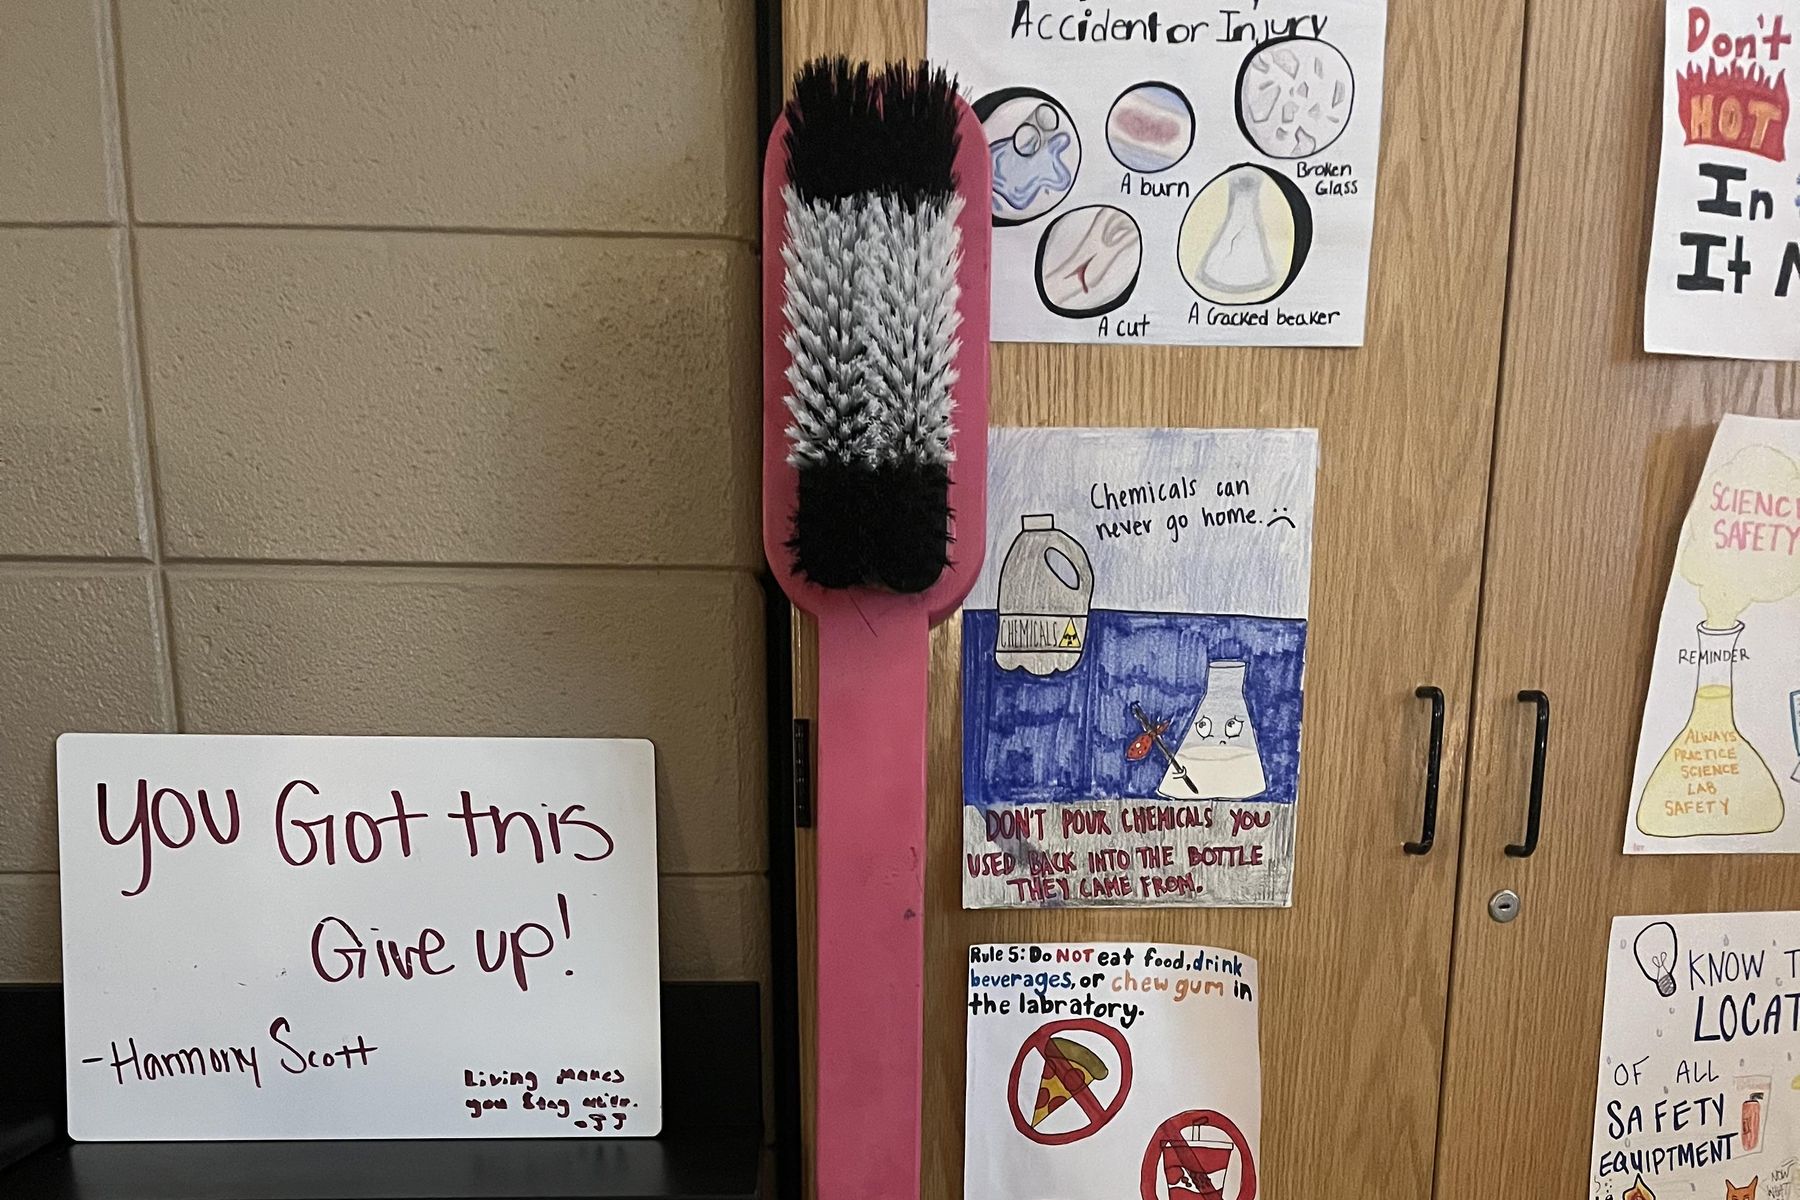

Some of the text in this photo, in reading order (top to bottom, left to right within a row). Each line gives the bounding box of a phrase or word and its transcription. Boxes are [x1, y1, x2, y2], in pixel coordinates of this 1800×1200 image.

[1011, 0, 1327, 45] Accident or Injury
[1687, 6, 1792, 61] Don't
[1690, 94, 1782, 150] HOT
[1121, 173, 1189, 198] A burn
[1297, 162, 1352, 178] Broken
[1316, 179, 1358, 195] Glass
[1697, 162, 1774, 221] In
[1677, 231, 1751, 294] It
[1099, 316, 1150, 337] A cut
[1189, 303, 1340, 325] A Cracked beaker
[1091, 476, 1250, 510] Chemicals can
[1096, 508, 1264, 542] never go home.
[1714, 518, 1800, 556] SAFETY
[1001, 619, 1058, 648] CHEMICALS
[1679, 648, 1750, 665] REMINDER
[1685, 729, 1737, 744] ALWAYS
[1674, 747, 1737, 762] PRACTICE
[1681, 764, 1739, 779] SCIENCE
[1688, 781, 1717, 795] LAB
[275, 780, 428, 866] Got
[447, 791, 614, 864] this
[1665, 798, 1729, 816] SAFETY
[986, 806, 1271, 841] DON'T POUR CHEMICALS YOU
[967, 845, 1263, 878] USED BACK INTO THE BOTTLE
[1006, 874, 1203, 901] THEY CAME FROM.
[311, 893, 574, 991] Give up!
[970, 947, 1003, 964] Rule
[1030, 946, 1052, 963] Do
[1056, 948, 1094, 963] NOT
[1097, 946, 1134, 967] eat
[1079, 975, 1105, 989] or
[1111, 970, 1169, 992] chew
[1175, 977, 1223, 1001] gum
[1232, 979, 1252, 1001] in
[1689, 949, 1765, 991] KNOW
[968, 992, 1145, 1029] the labratory.
[270, 1017, 378, 1074] Scott
[465, 1069, 538, 1091] Living
[1614, 1056, 1719, 1086] OF ALL
[1607, 1093, 1725, 1140] SAFETY
[1599, 1132, 1738, 1177] EQUIPTMENT
